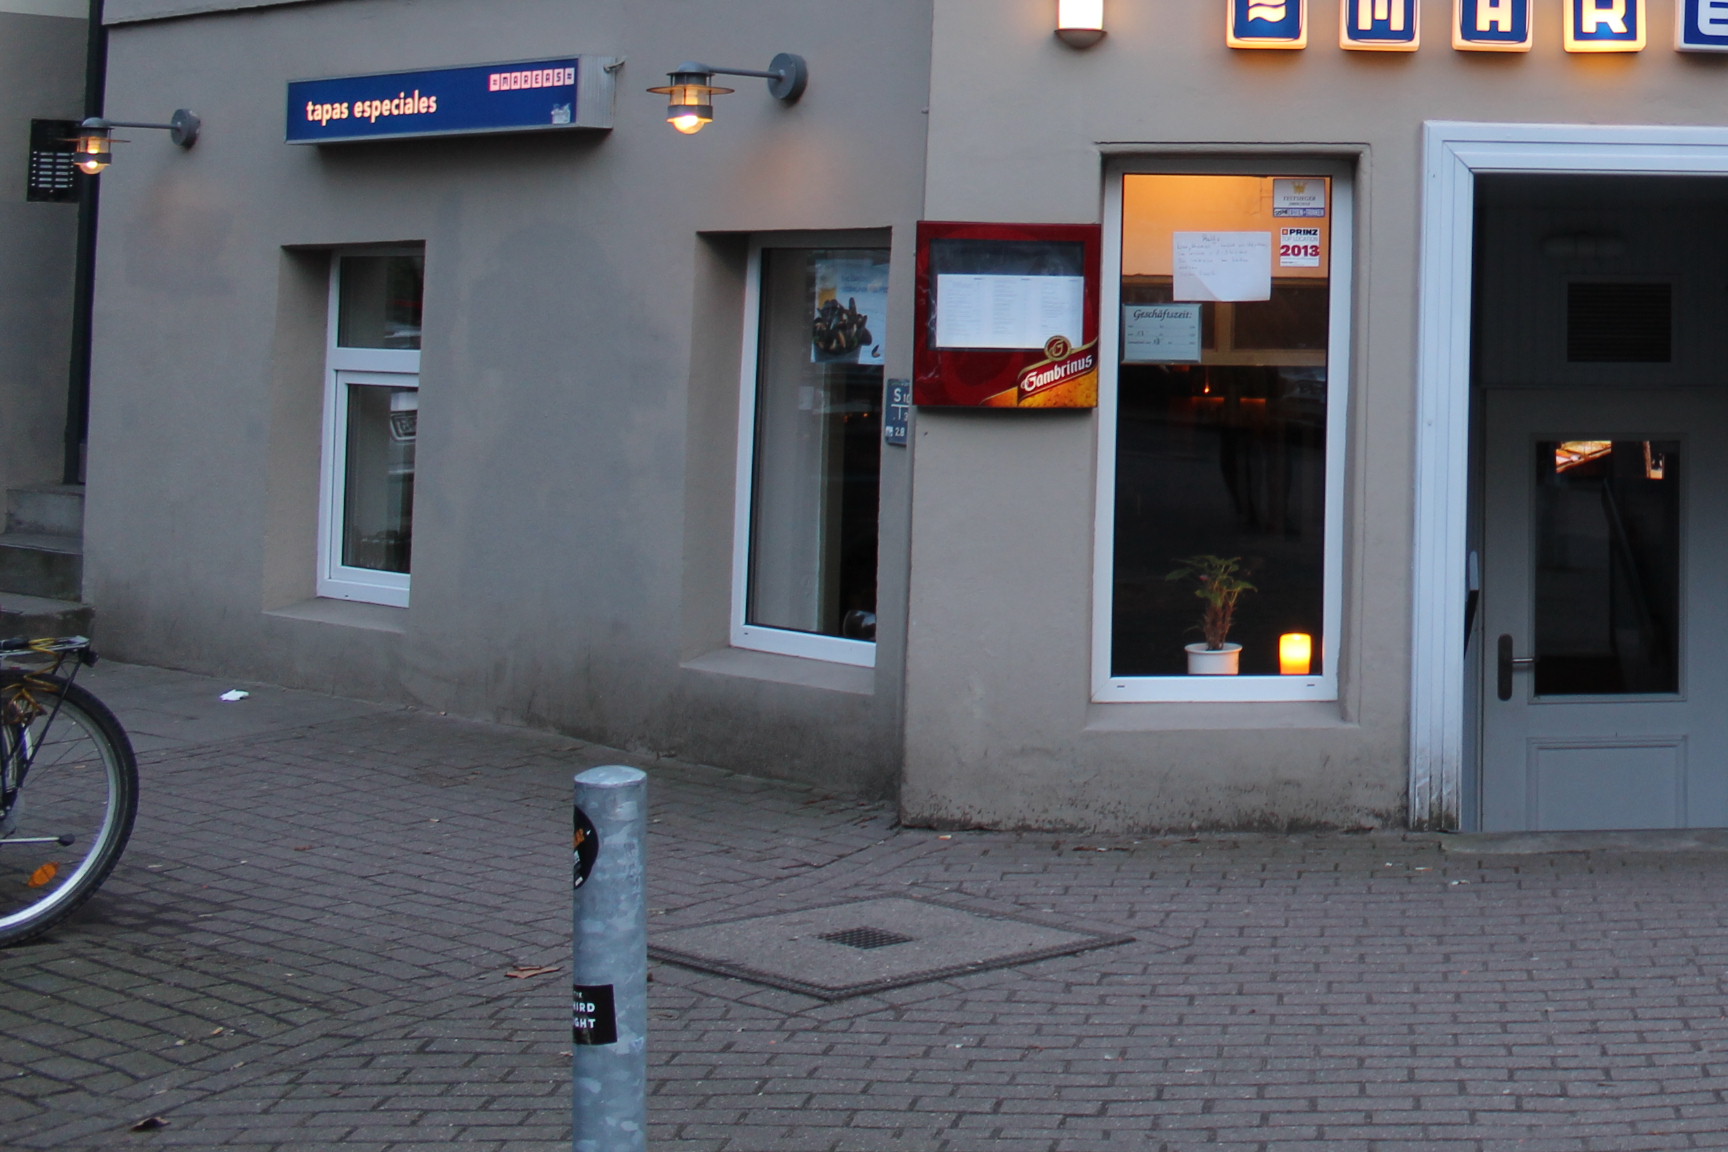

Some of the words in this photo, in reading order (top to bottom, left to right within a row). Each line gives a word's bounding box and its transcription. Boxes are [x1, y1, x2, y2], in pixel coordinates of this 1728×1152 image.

[306, 100, 349, 127] tapas
[354, 89, 437, 124] especiales
[1289, 228, 1318, 236] PRINZ
[1280, 244, 1320, 257] 2013
[1133, 309, 1192, 321] Geschäftszeit:
[1020, 354, 1093, 392] Gambrinus
